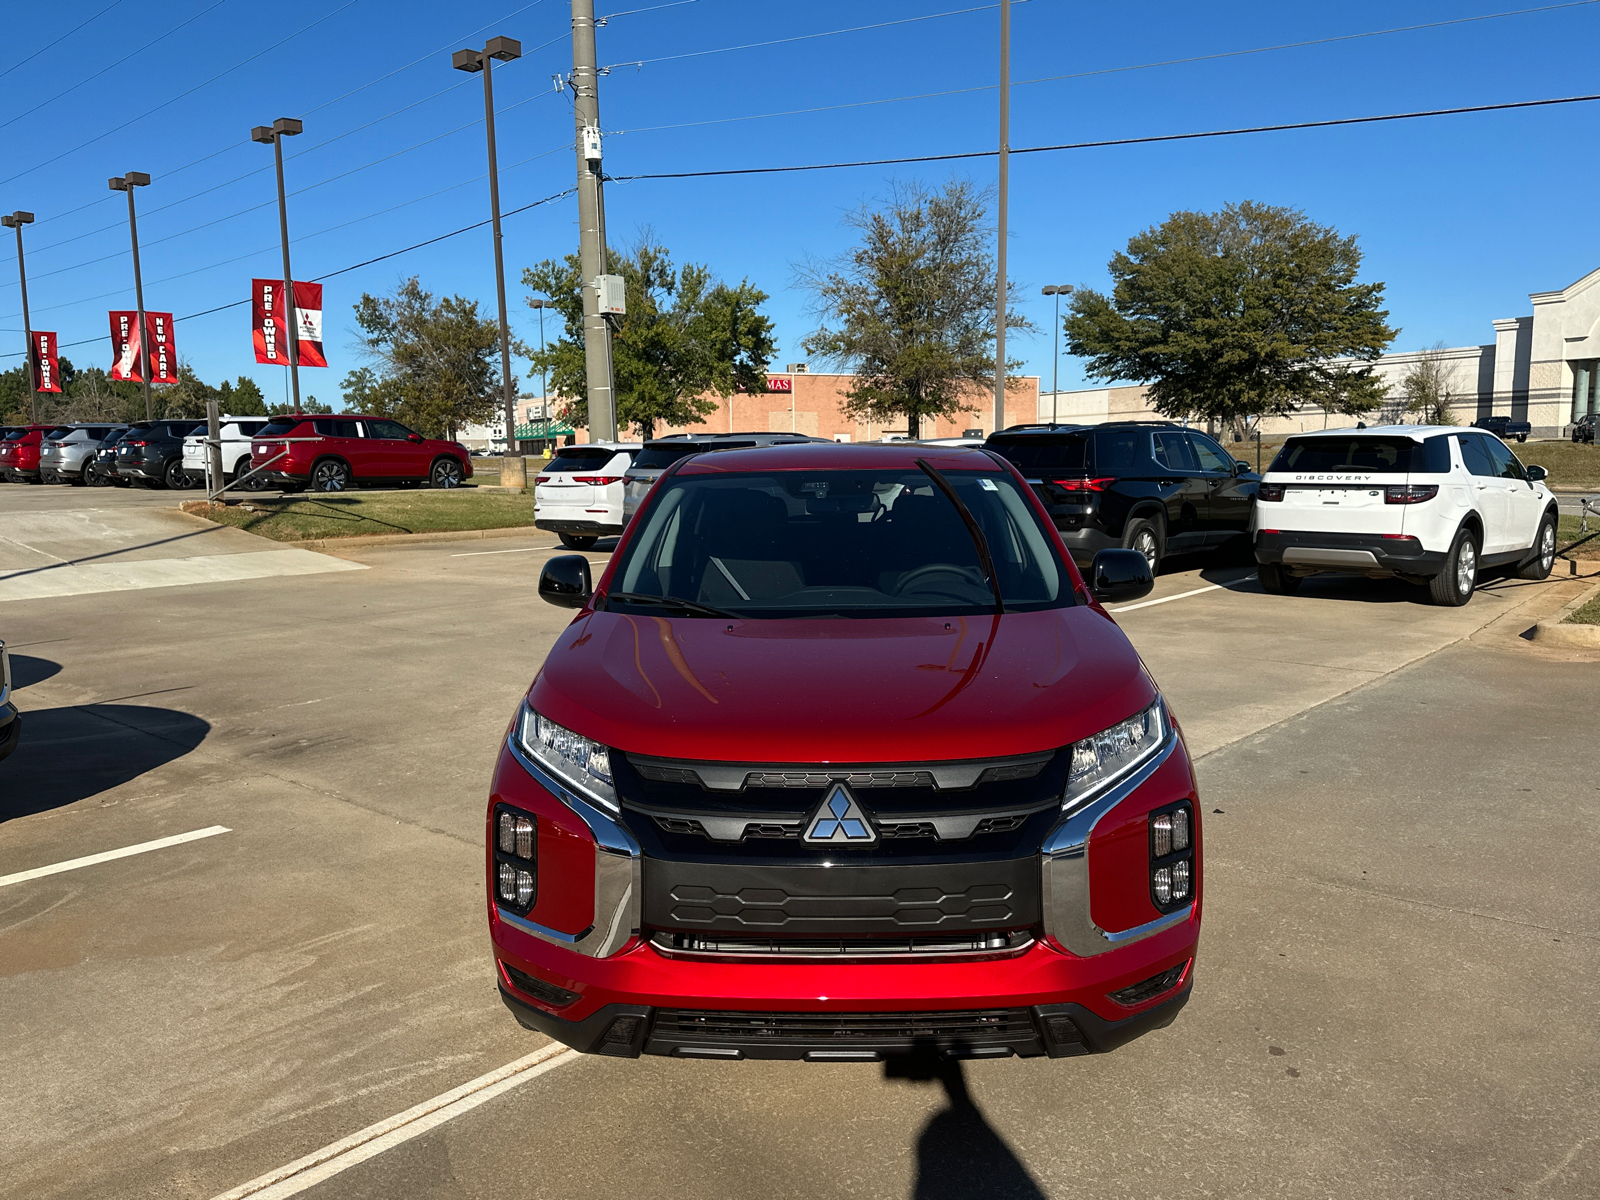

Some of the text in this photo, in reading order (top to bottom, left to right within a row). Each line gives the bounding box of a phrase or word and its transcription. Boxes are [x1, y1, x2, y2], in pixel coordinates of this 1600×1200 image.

[155, 317, 167, 379] NEW CARS
[263, 286, 277, 359] PRE-OWNED
